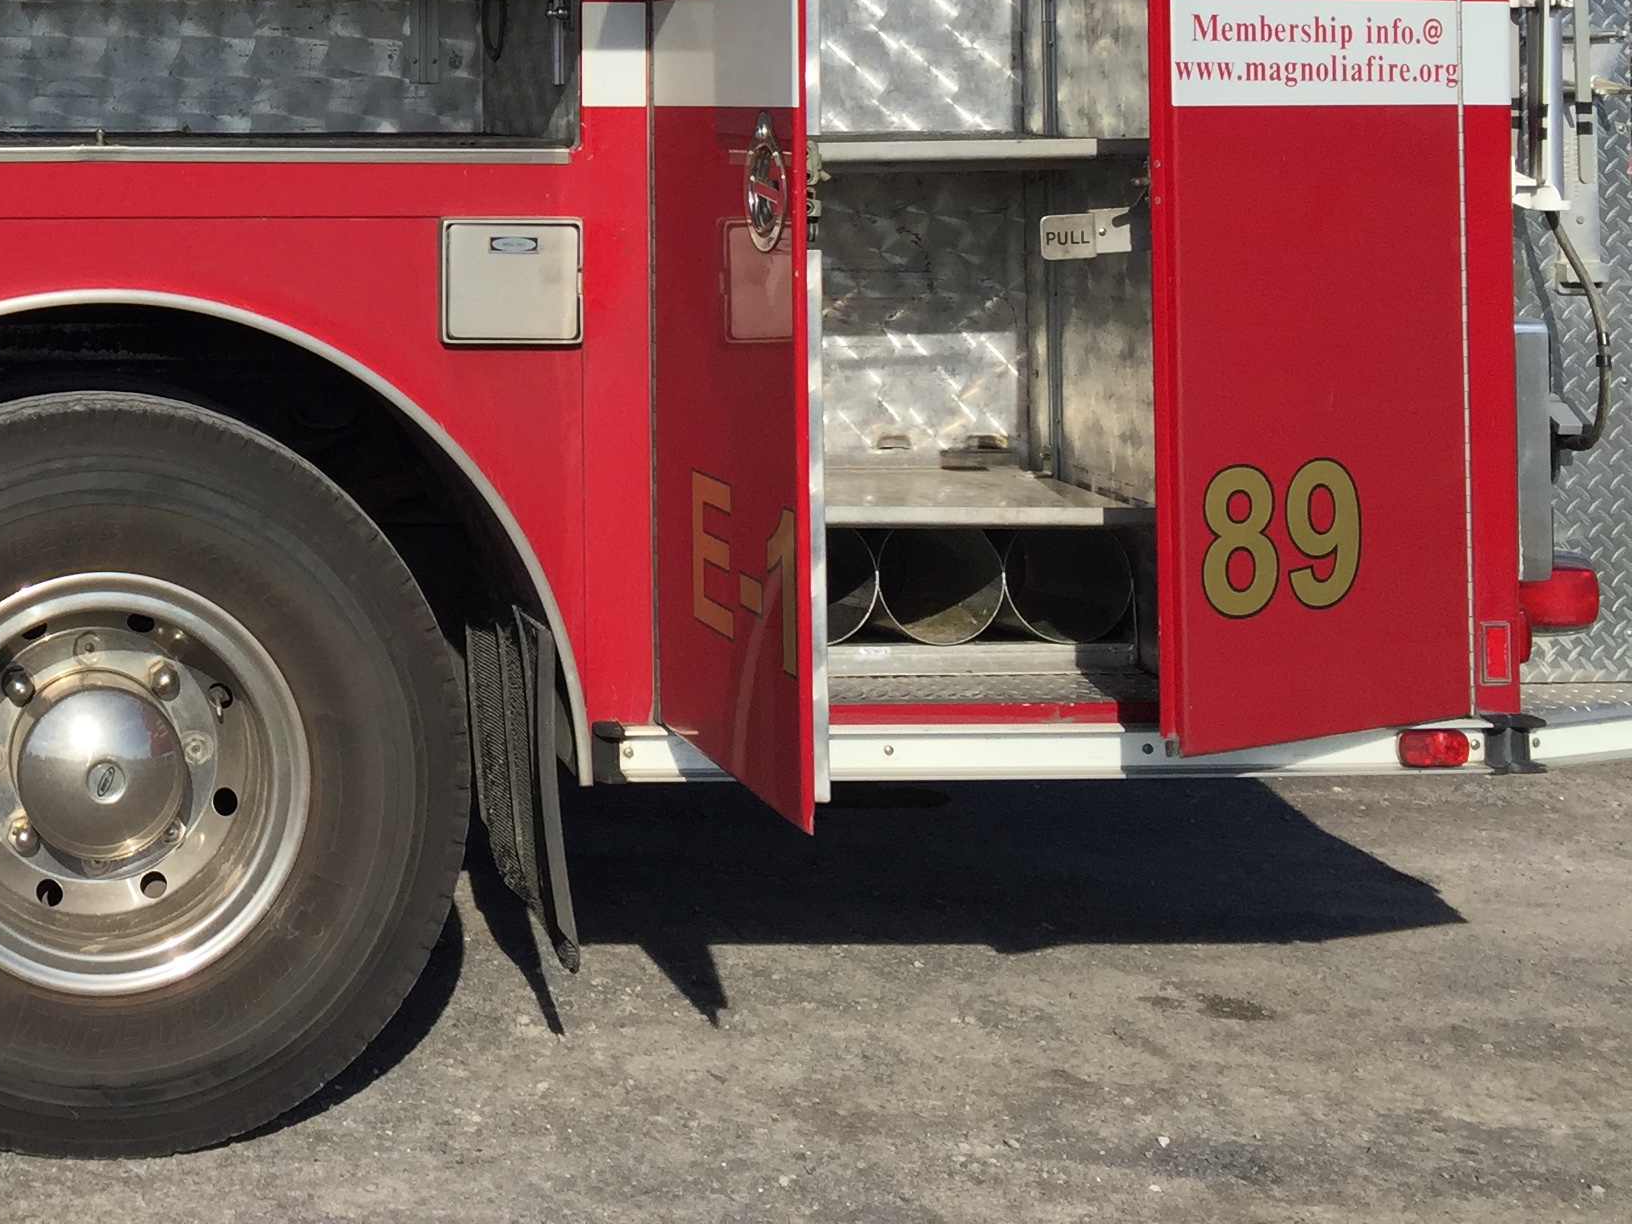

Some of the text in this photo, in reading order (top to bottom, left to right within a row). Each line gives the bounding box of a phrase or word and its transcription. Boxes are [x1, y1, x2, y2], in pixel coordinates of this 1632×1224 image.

[1191, 13, 1443, 50] Membership info.@
[1174, 54, 1459, 88] www.magnoliafire.org
[1045, 230, 1090, 246] PULL
[1201, 457, 1362, 619] 89
